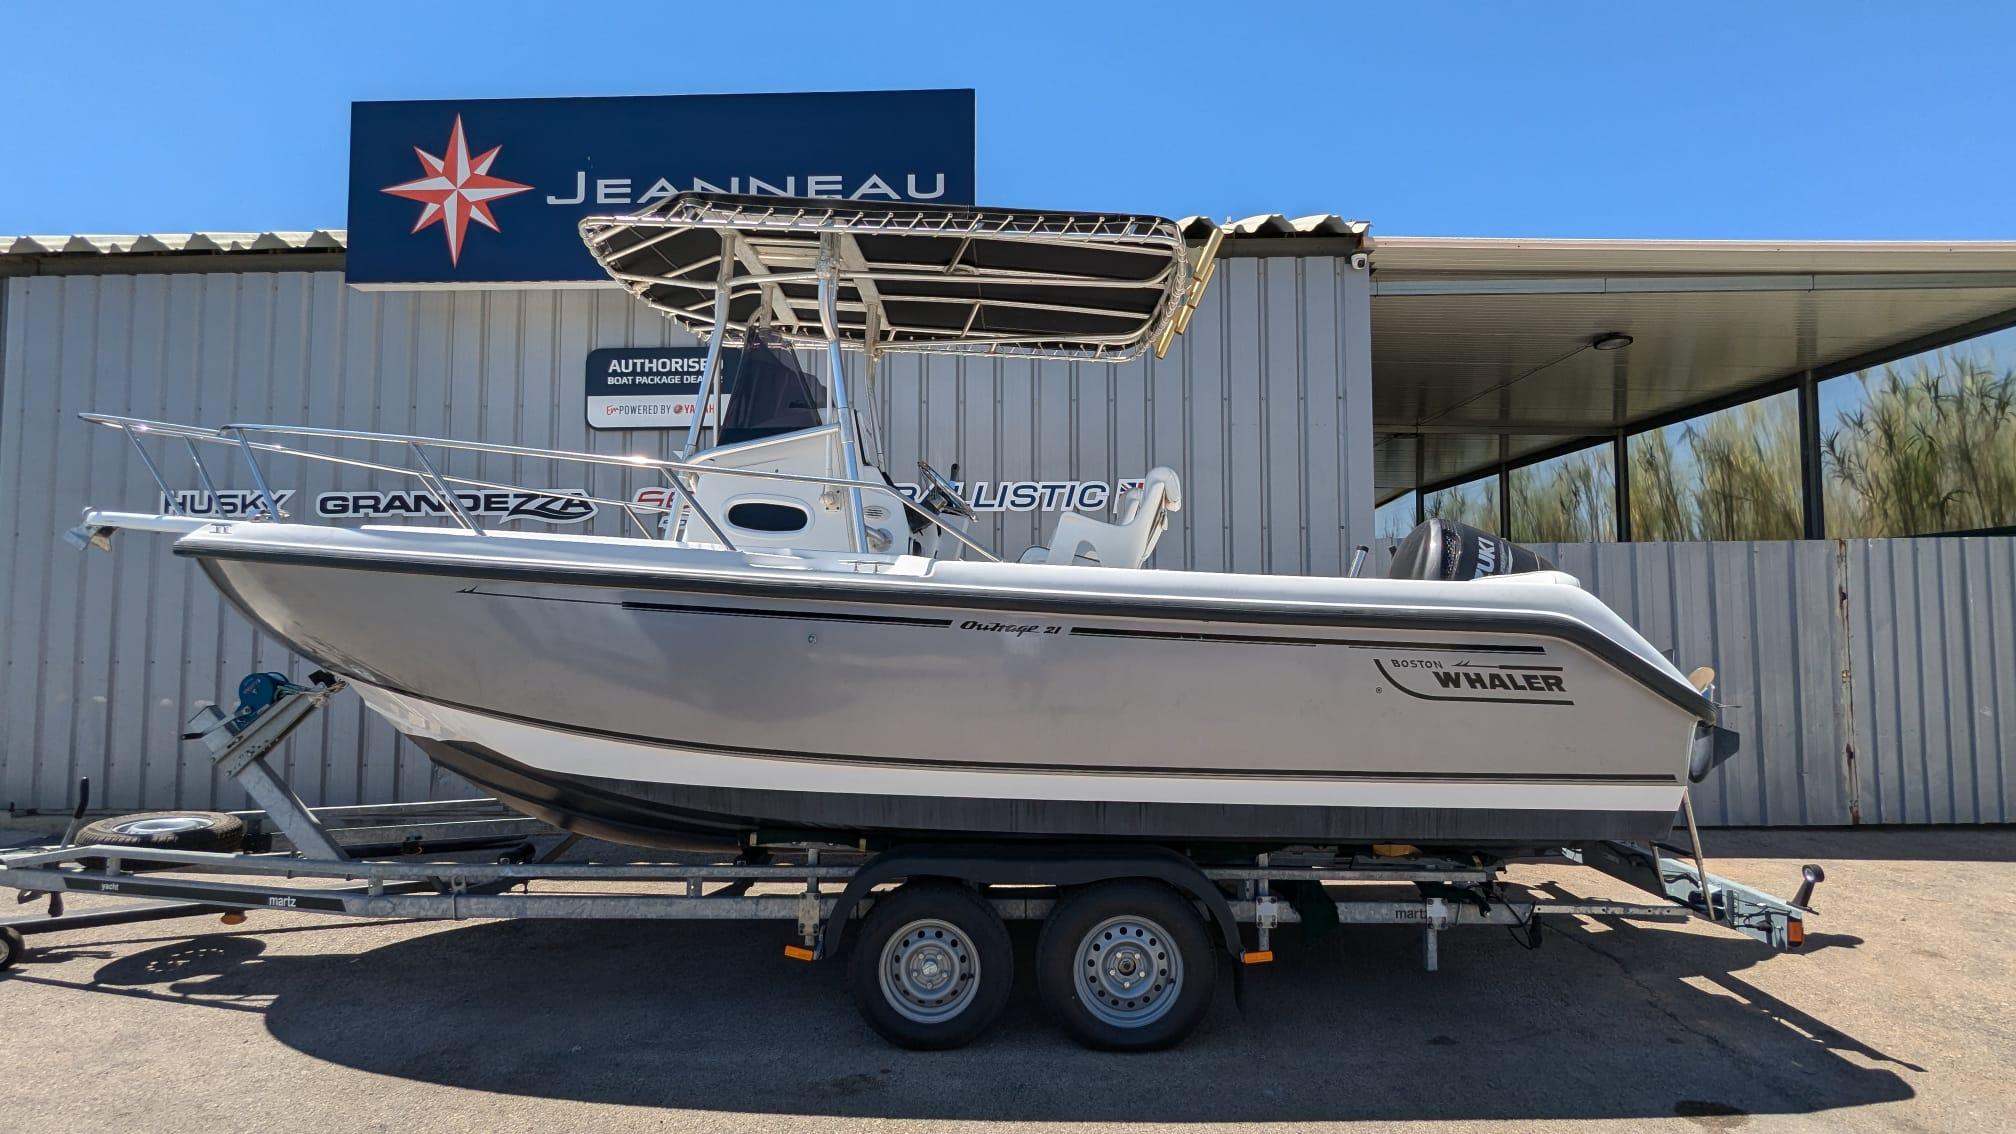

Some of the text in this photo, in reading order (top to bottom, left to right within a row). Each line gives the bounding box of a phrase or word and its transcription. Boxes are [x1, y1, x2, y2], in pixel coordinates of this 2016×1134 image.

[546, 171, 945, 205] JEANNEAU
[608, 358, 723, 373] AUTHORISE
[607, 376, 634, 385] BOAT
[635, 375, 681, 384] PACKAGE
[660, 404, 671, 415] BY
[163, 493, 289, 515] HUSKY
[894, 484, 1107, 508] LISTIC
[319, 492, 594, 521] GRANDEZZA
[1474, 536, 1495, 580] UKI
[960, 620, 1062, 638] Outrage 21
[1391, 659, 1444, 670] BOSTON
[1432, 671, 1567, 692] WHALER
[101, 882, 120, 892] yacht
[269, 895, 296, 908] martz
[1395, 909, 1428, 920] mart
